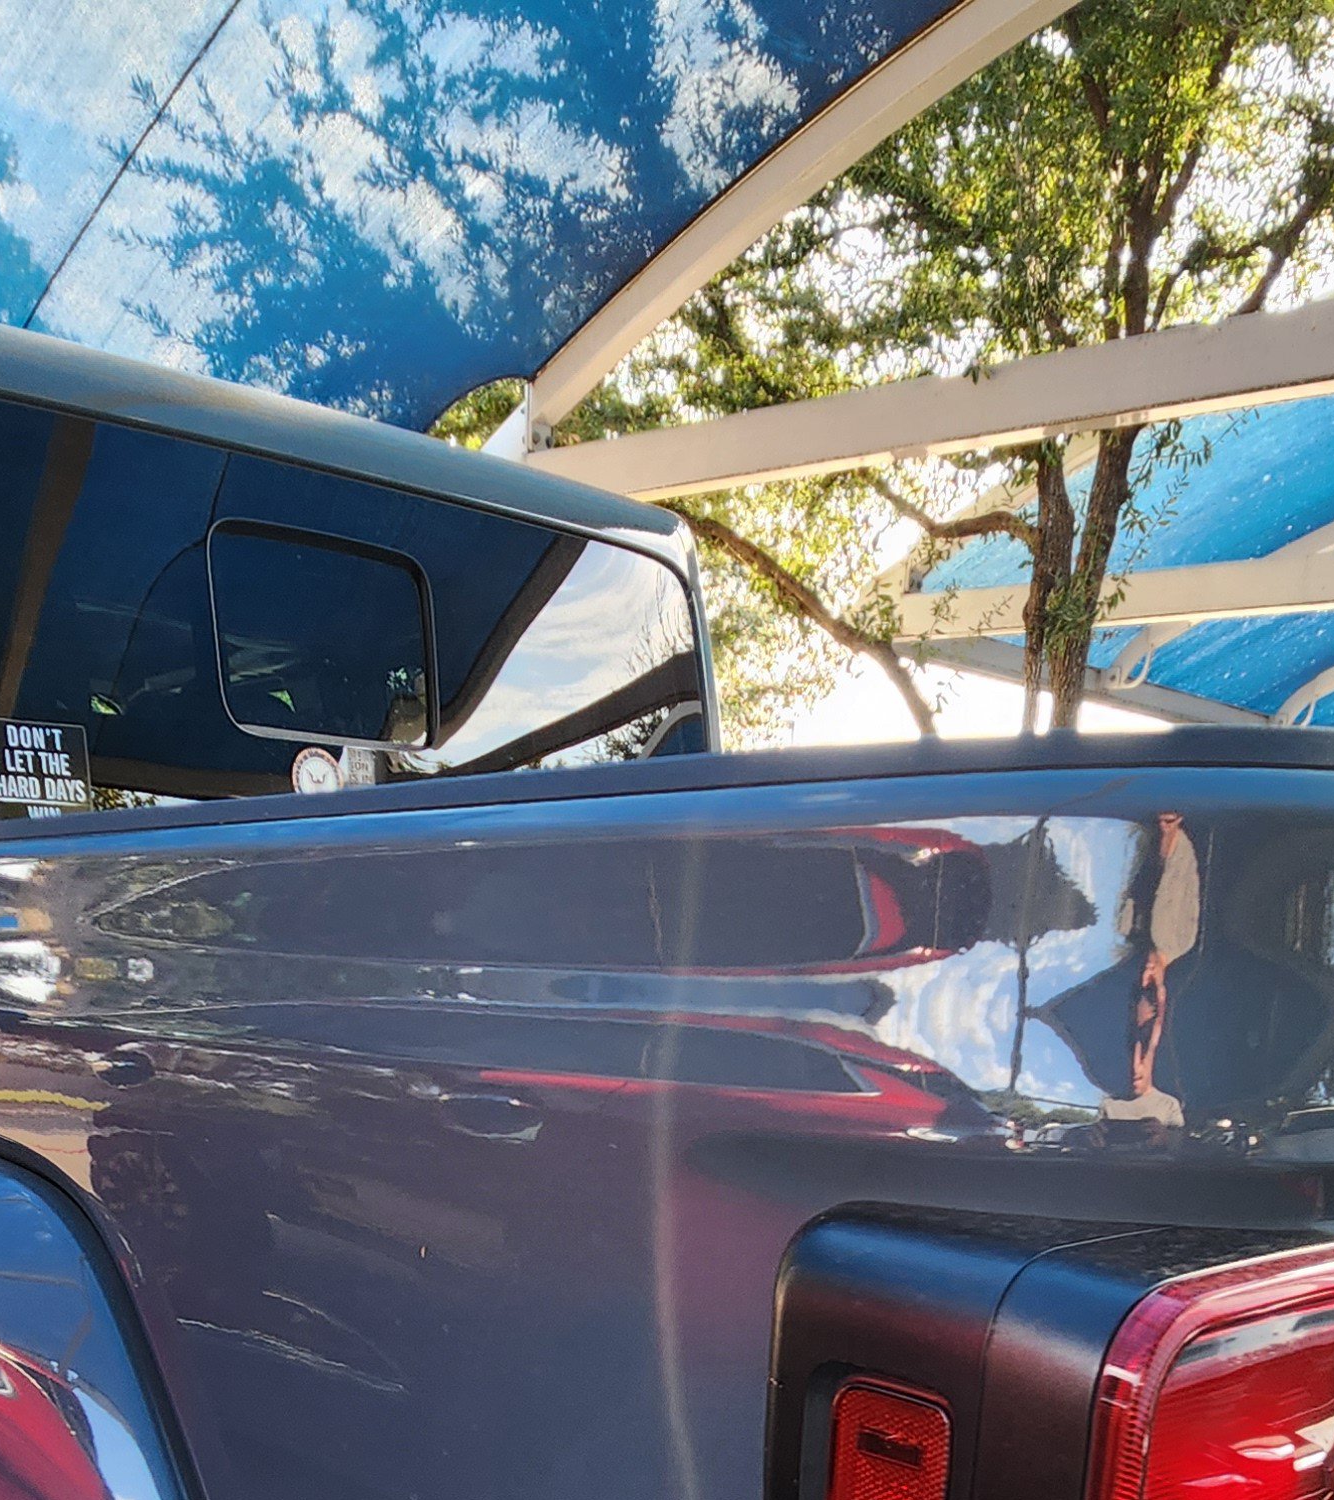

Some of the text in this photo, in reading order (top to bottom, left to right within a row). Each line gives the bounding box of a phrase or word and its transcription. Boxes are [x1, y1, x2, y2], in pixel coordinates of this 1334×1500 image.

[6, 724, 62, 751] DON'T
[5, 748, 71, 776] LET THE
[44, 777, 87, 803] DAYS
